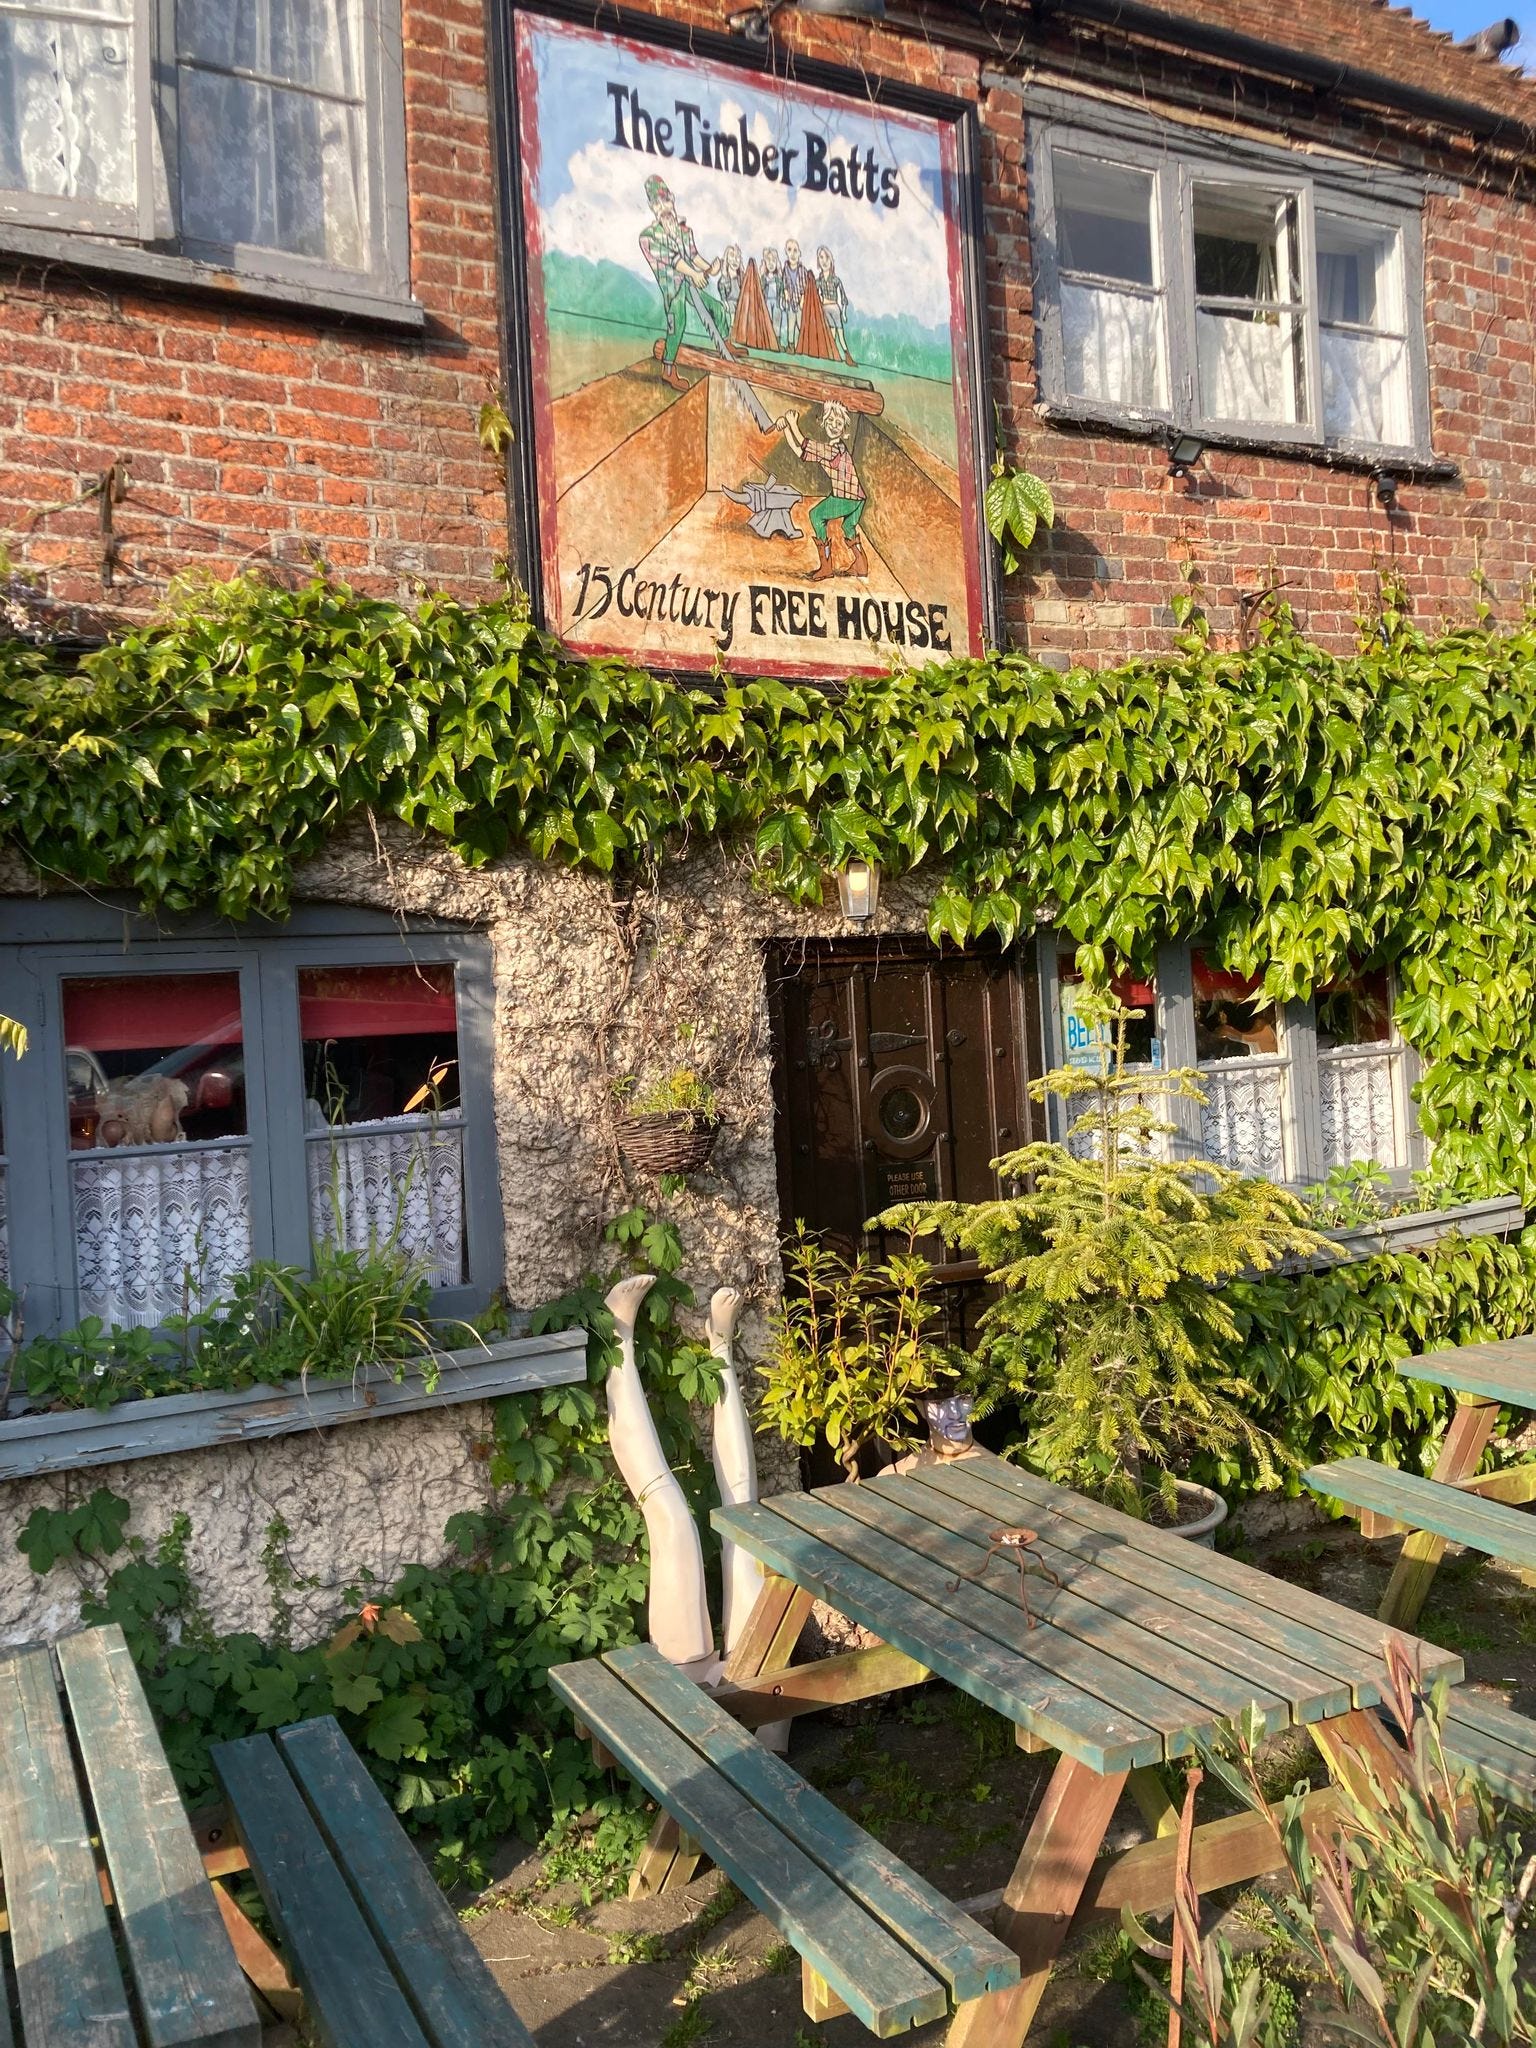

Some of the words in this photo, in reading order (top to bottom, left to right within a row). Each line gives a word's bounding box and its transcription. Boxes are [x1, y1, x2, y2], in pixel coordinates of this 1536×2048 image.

[607, 81, 674, 157] The
[675, 100, 799, 186] Timber
[803, 130, 900, 209] Batts
[616, 567, 740, 651] Century
[749, 585, 828, 639] FREE
[837, 596, 952, 652] HOUSE
[887, 1172, 910, 1182] PLEASE
[911, 1171, 924, 1181] USE
[889, 1183, 910, 1196] OTHER
[910, 1182, 927, 1195] DOOR
